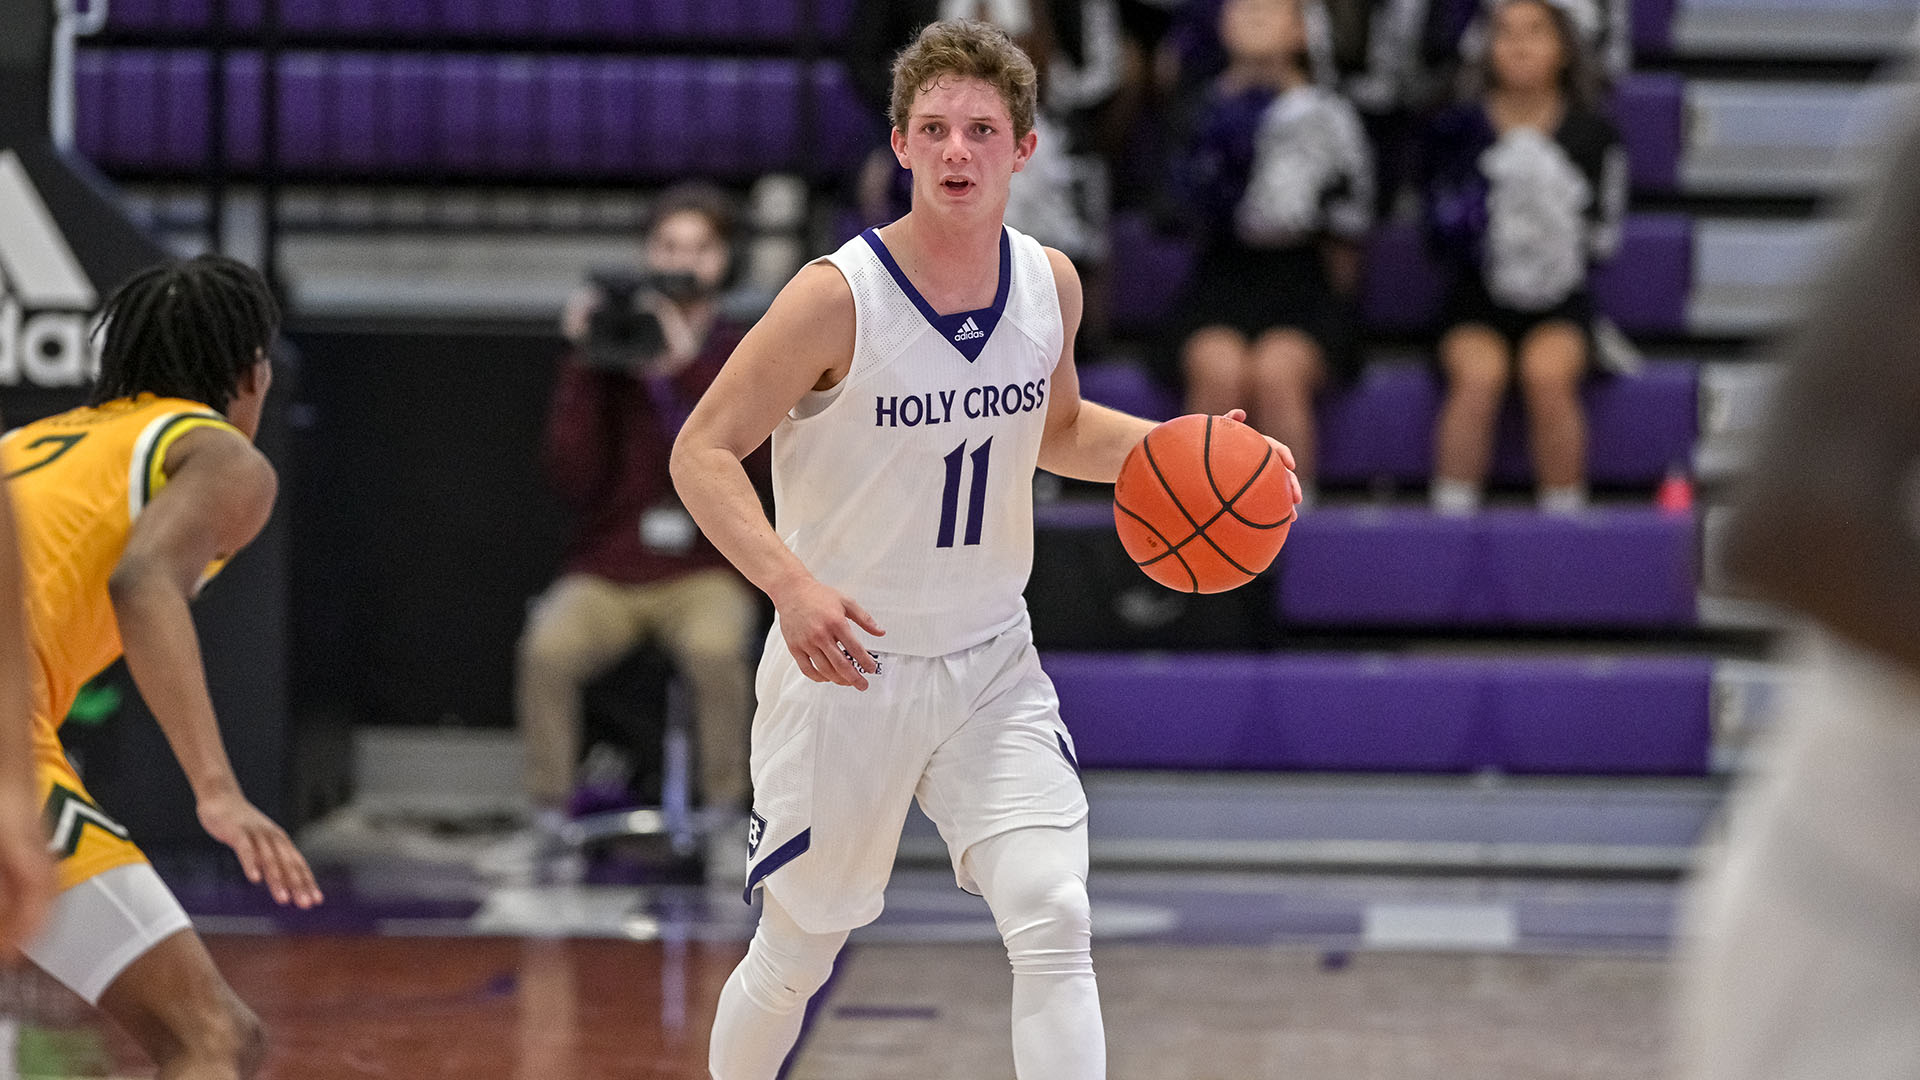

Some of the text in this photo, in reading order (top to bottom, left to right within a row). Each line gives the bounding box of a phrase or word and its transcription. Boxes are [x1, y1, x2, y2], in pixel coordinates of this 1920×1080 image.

[954, 330, 984, 341] adidas
[875, 378, 1046, 427] HOLY CROSS
[936, 435, 994, 548] 11
